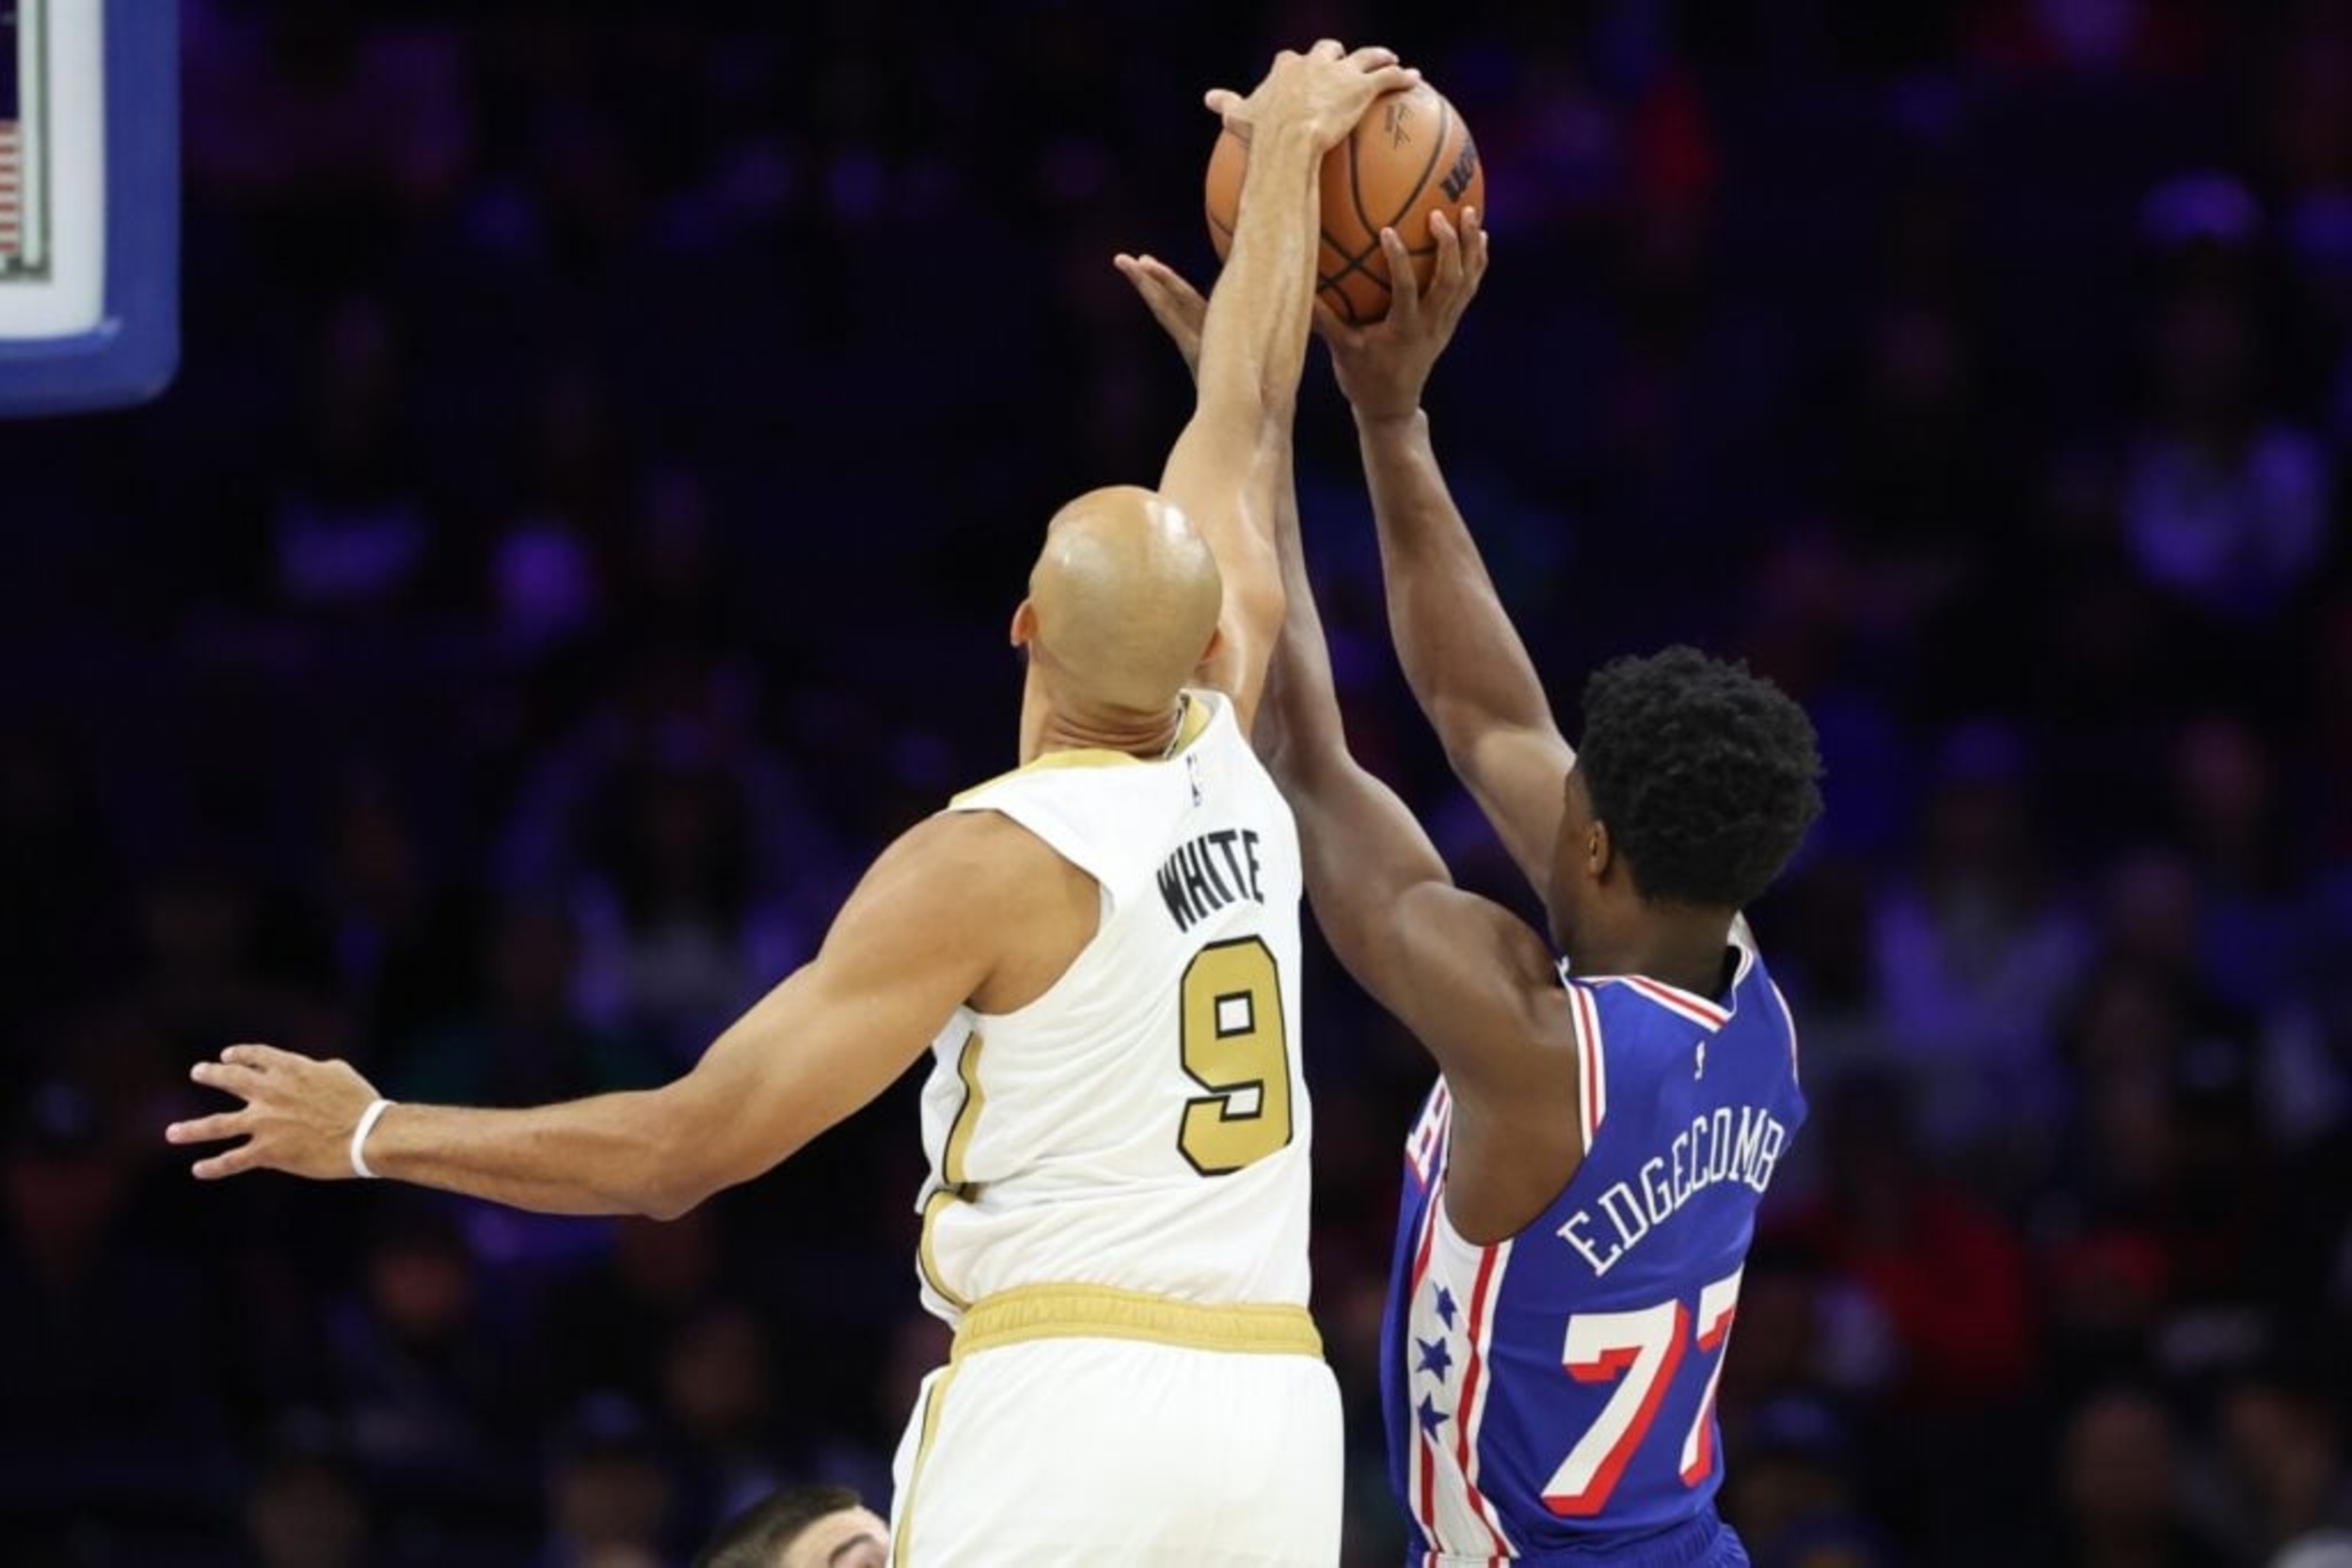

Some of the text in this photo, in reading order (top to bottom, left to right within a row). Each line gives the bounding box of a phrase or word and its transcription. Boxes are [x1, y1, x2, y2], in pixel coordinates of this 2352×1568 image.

[1157, 830, 1263, 933] WHITE
[1177, 934, 1295, 1178] 9
[1540, 1261, 1746, 1516] 77
